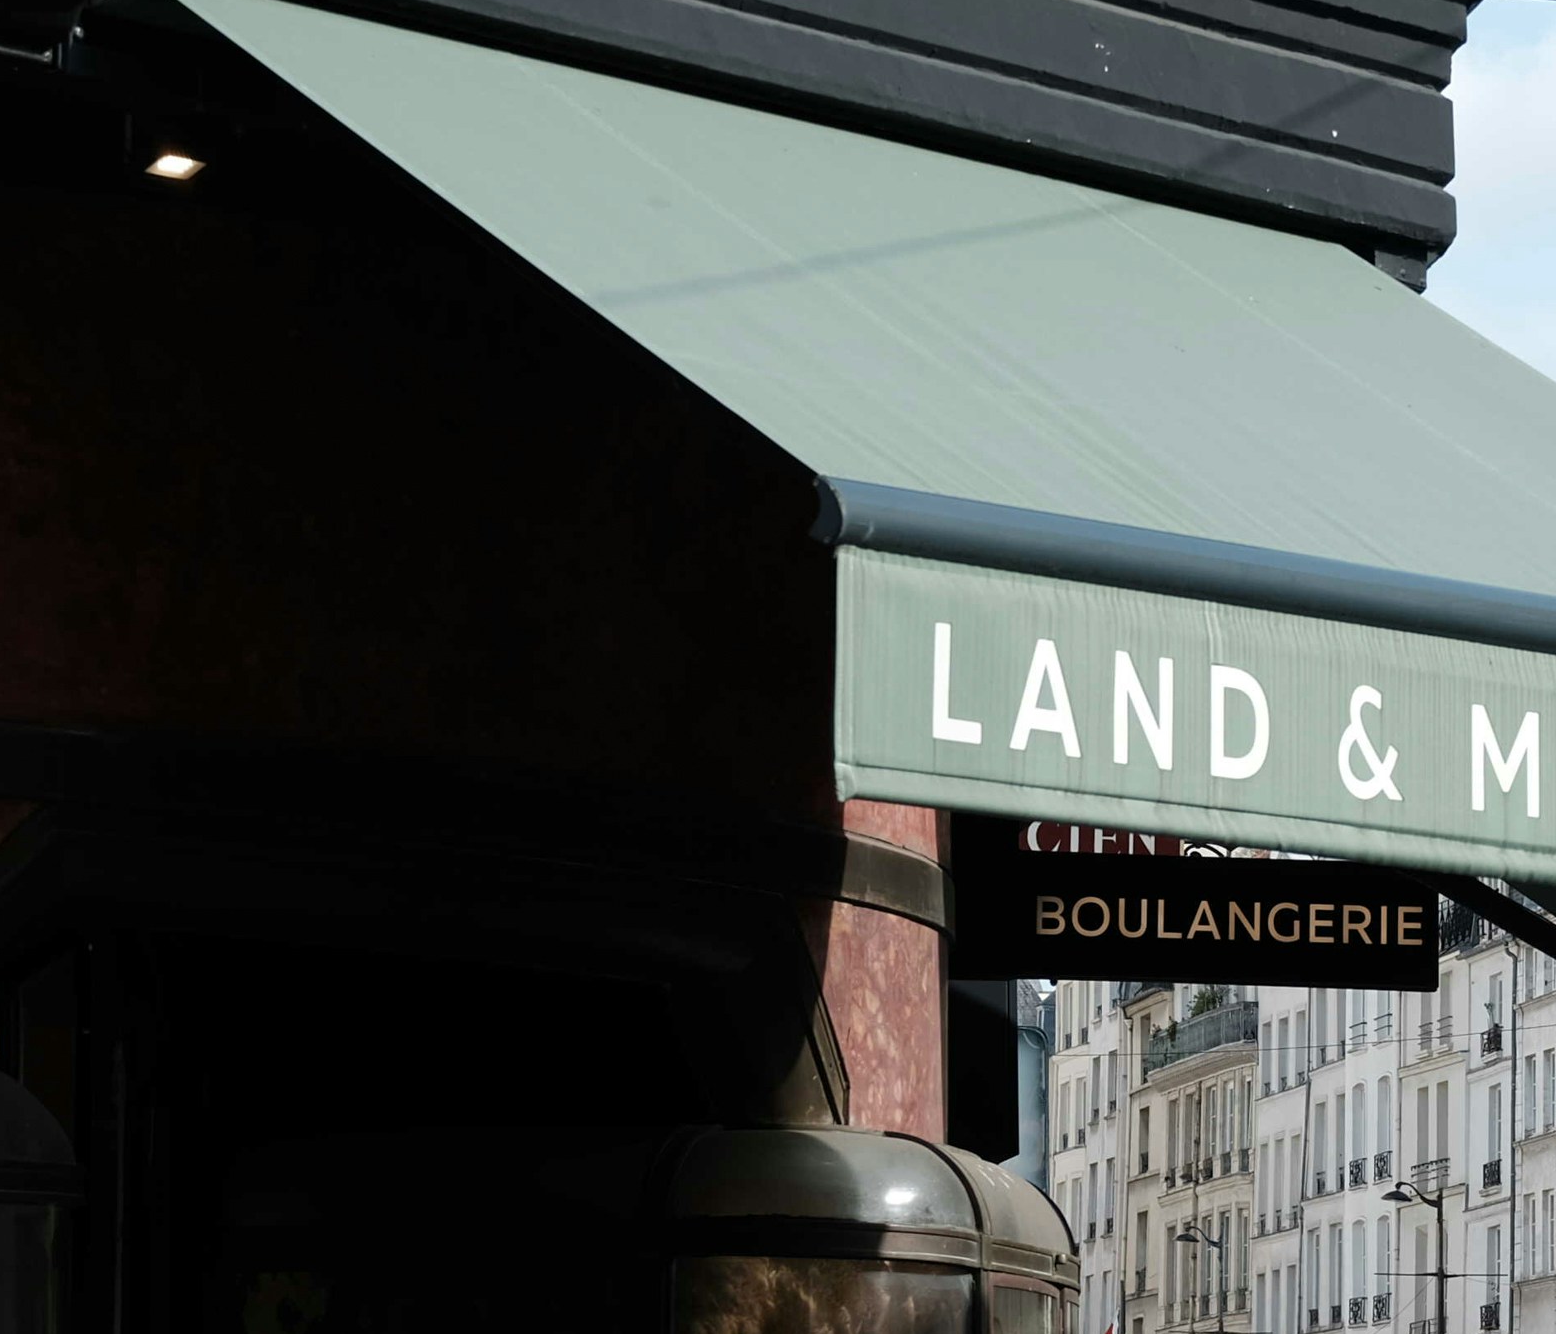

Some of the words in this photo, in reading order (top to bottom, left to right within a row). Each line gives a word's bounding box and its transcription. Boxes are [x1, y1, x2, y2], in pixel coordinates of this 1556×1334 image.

[932, 622, 1270, 780] LAND
[1338, 684, 1403, 802] &
[1035, 895, 1424, 946] BOULANGERIE
